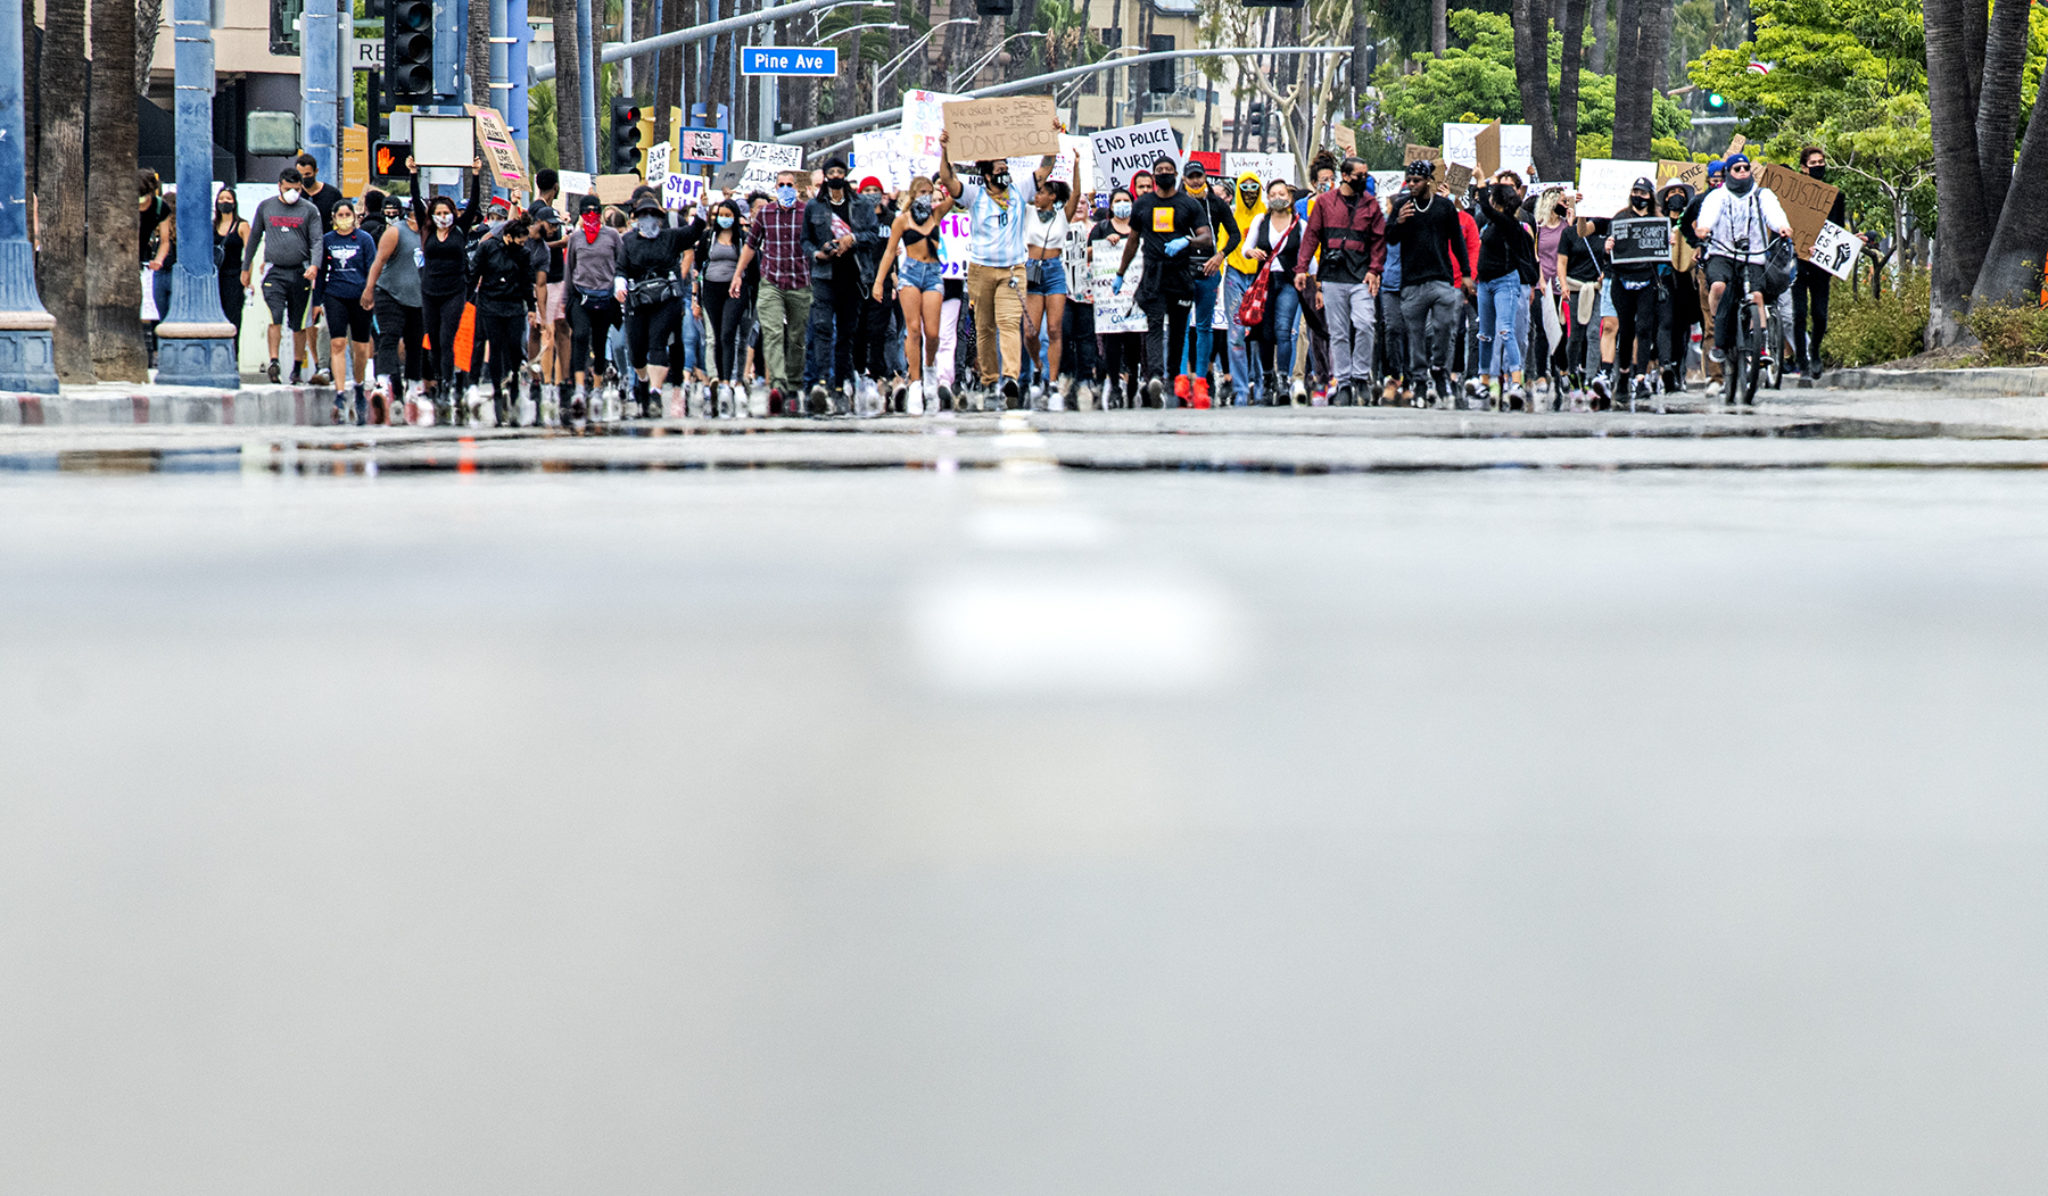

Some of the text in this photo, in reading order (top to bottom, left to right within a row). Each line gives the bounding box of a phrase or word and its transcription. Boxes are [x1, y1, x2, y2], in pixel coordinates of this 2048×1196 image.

[755, 53, 824, 69] Pine Ave
[1012, 100, 1048, 115] PEACE
[1095, 127, 1169, 155] END POLICE
[1231, 156, 1260, 169] Where
[1266, 157, 1273, 167] is
[1660, 163, 1703, 183] NO STICE
[1760, 167, 1836, 215] NO JUSTICE
